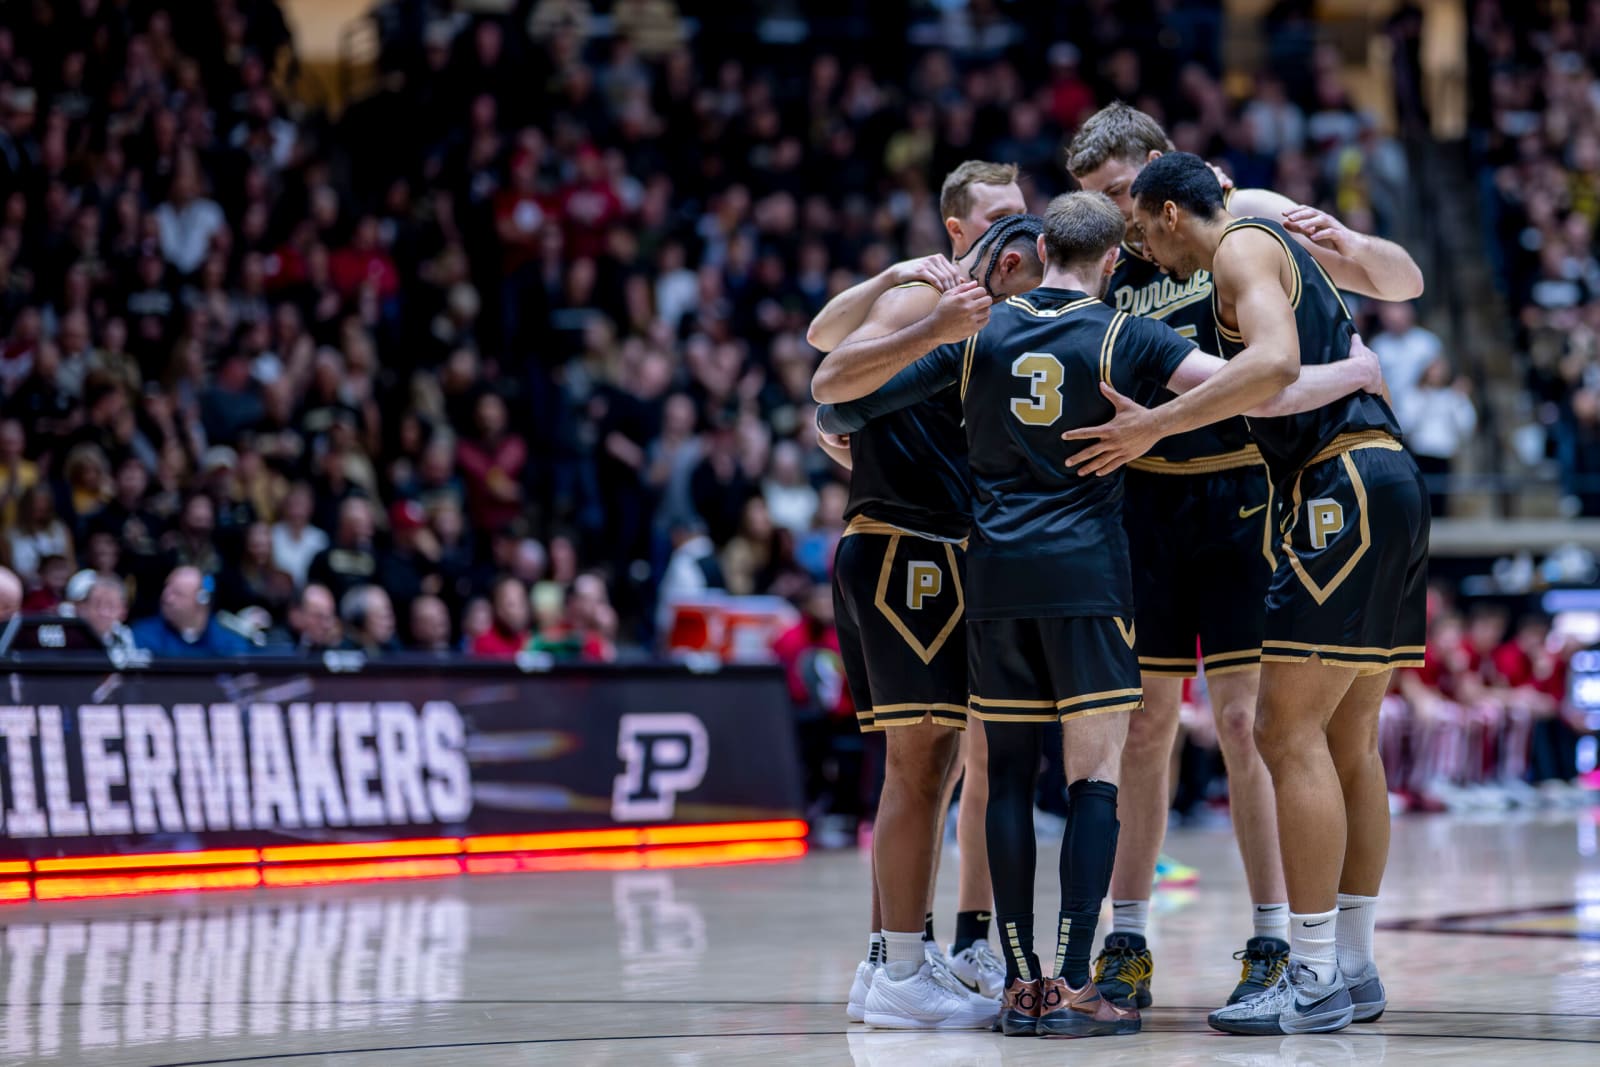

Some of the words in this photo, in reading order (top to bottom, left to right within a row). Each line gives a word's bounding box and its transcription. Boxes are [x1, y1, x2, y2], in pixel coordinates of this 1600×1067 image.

[1010, 352, 1064, 426] 3
[1307, 498, 1344, 549] P
[906, 560, 942, 609] P
[0, 700, 472, 838] ILERMAKERS
[611, 712, 709, 822] P
